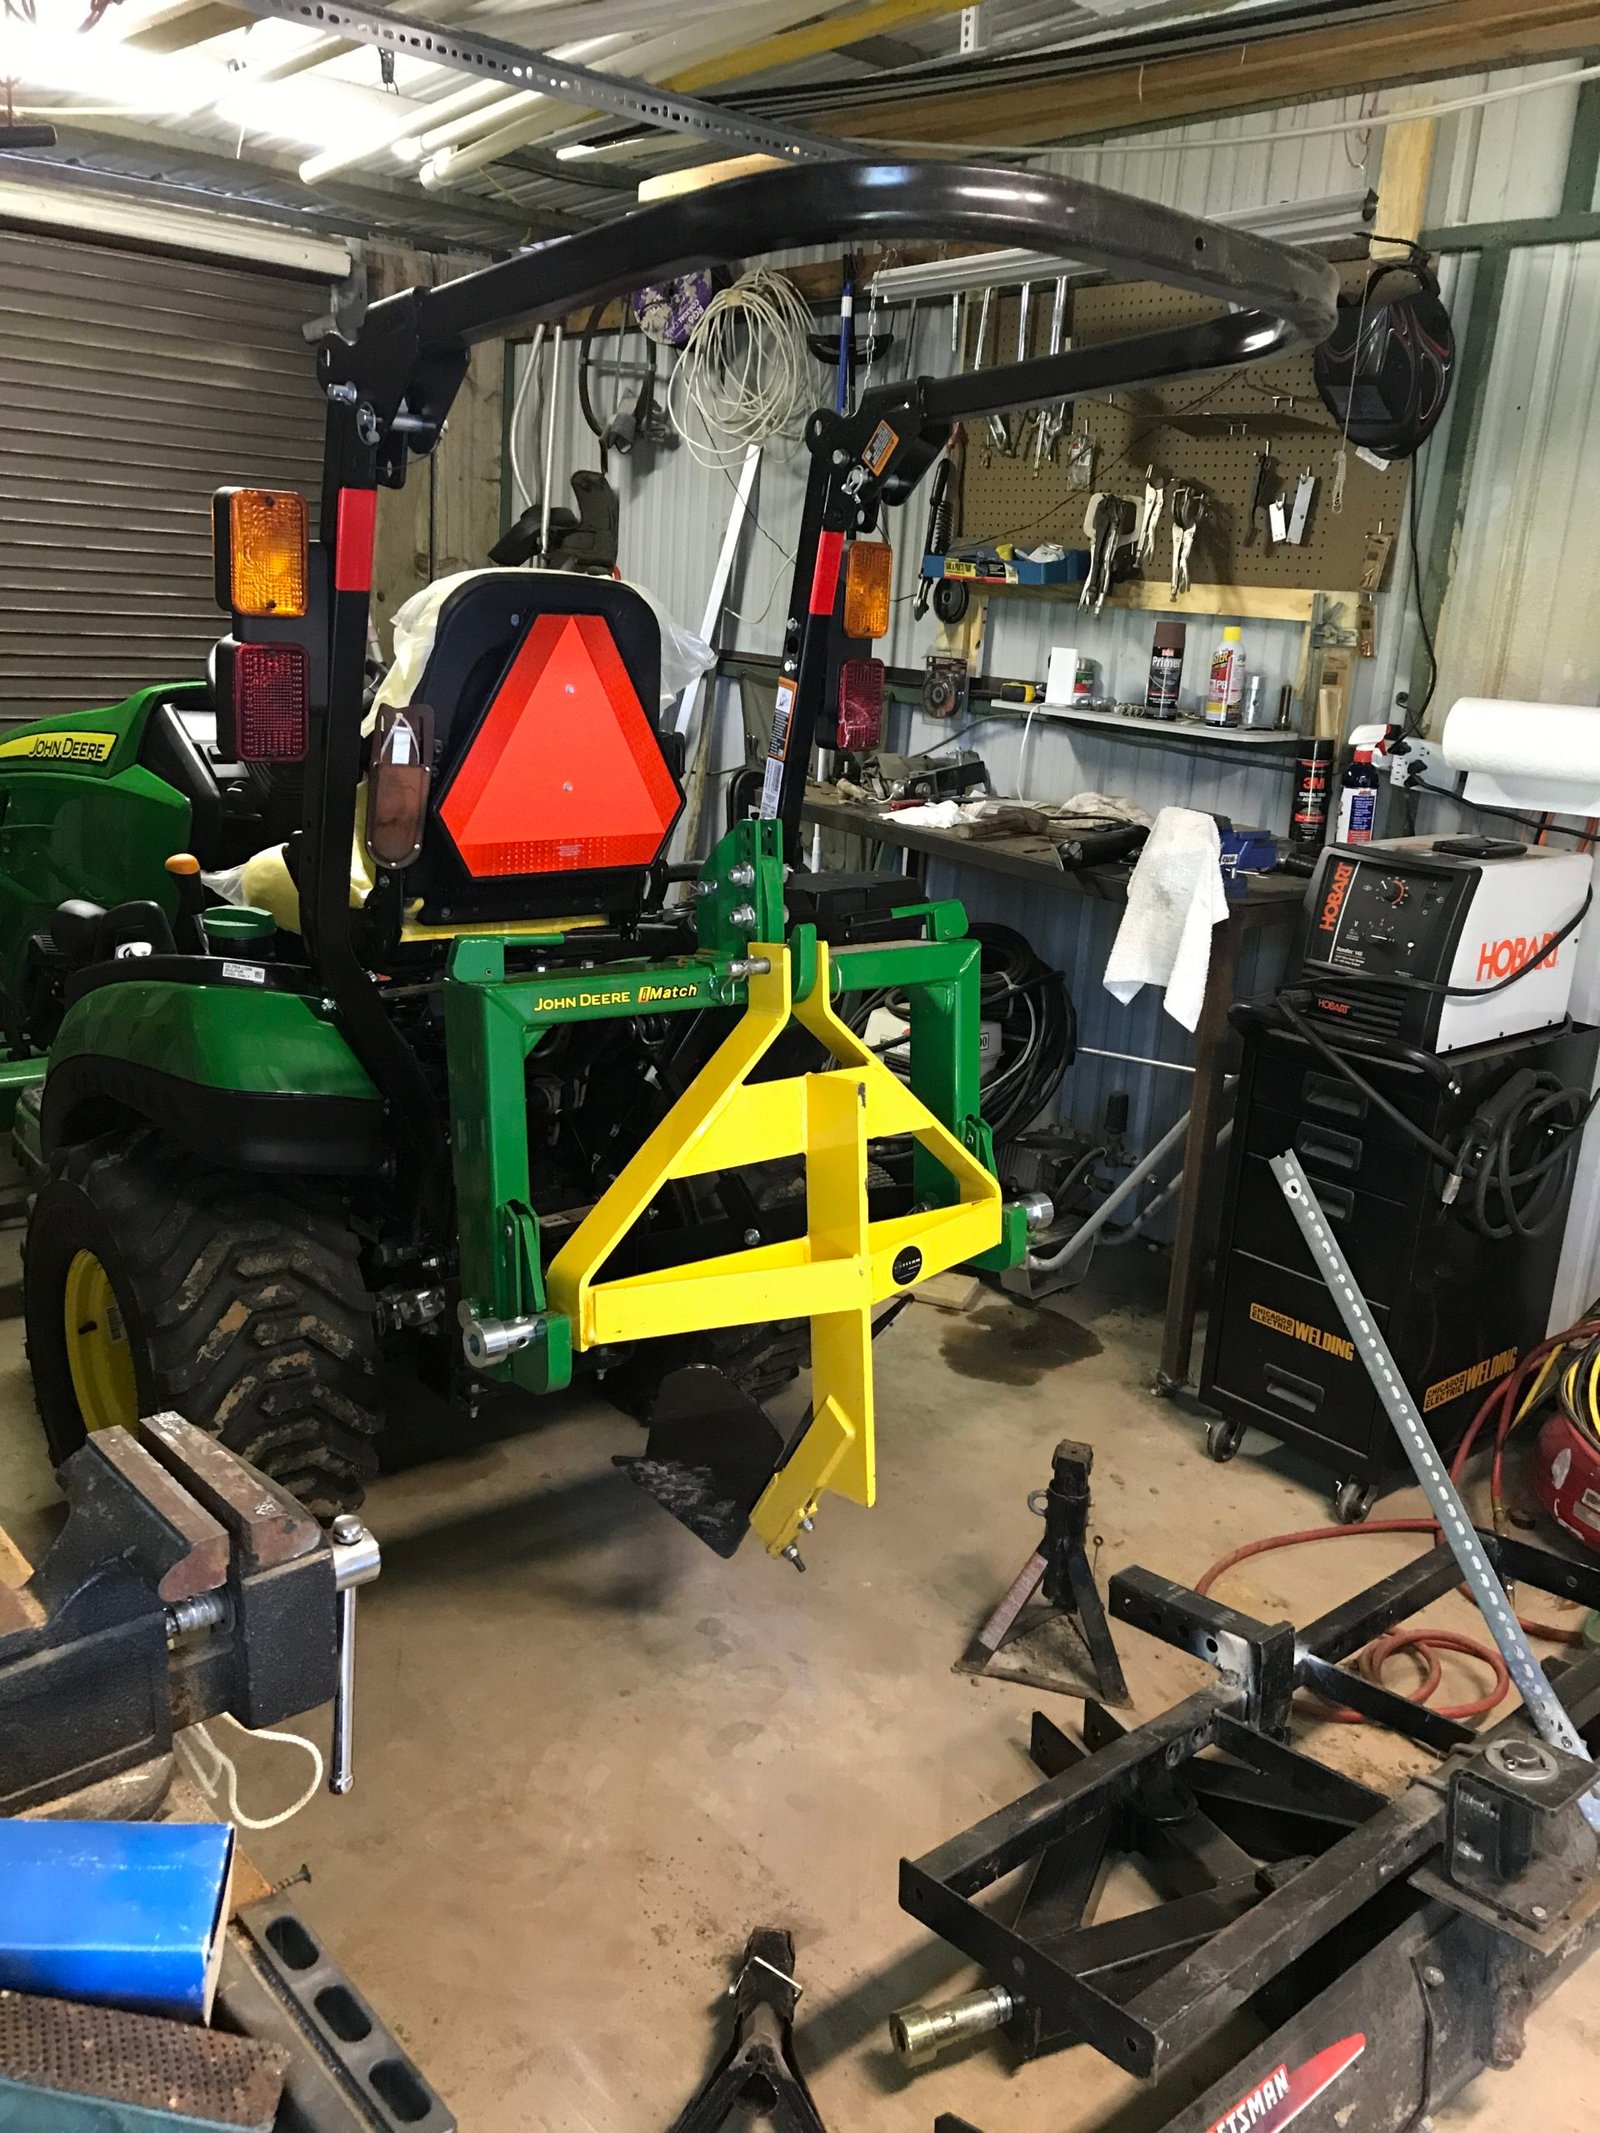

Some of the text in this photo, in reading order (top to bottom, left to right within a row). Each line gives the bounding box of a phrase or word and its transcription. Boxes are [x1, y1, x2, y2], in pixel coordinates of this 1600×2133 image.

[1152, 656, 1182, 668] Primer
[29, 737, 105, 759] JOHN DEERE
[1303, 776, 1325, 789] 3M
[1319, 862, 1354, 932] HOBART
[534, 997, 577, 1011] JOHN
[580, 990, 631, 1007] DEERE
[1318, 998, 1351, 1014] HOBART
[1252, 1305, 1289, 1325] CHICAGO
[1251, 1311, 1355, 1361] ELECTRIC WELDING
[1425, 1346, 1518, 1409] ELECTRIC WELDING
[1427, 1376, 1461, 1399] CHICAGO
